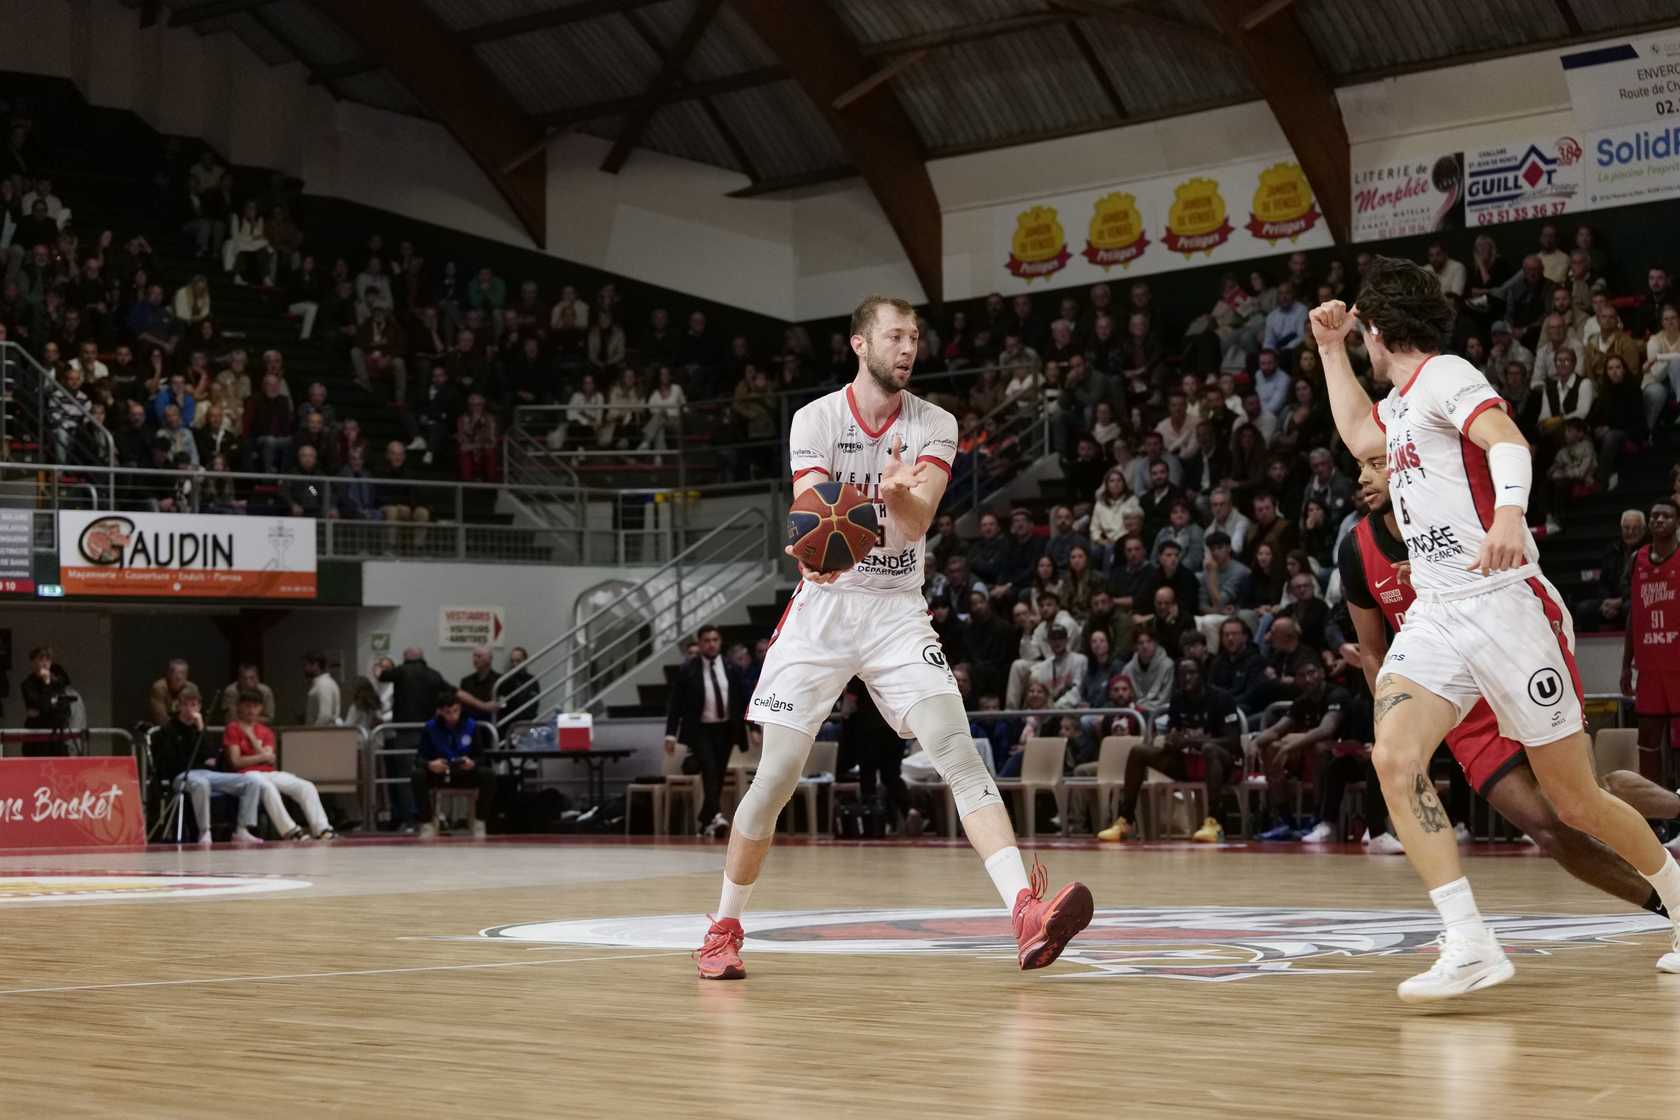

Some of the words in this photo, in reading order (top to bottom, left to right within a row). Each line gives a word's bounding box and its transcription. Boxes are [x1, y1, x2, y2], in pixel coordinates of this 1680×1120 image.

[1619, 87, 1649, 100] Route
[1651, 84, 1664, 95] de
[1655, 99, 1680, 116] 02.
[1354, 165, 1410, 184] LITERIE
[1415, 163, 1428, 175] de
[1478, 211, 1493, 225] 02
[1497, 209, 1510, 223] 51
[1551, 201, 1566, 216] 37
[78, 516, 234, 569] GAUDIN
[860, 549, 918, 570] ENDÉE
[1651, 610, 1665, 629] 91
[1643, 631, 1679, 645] SKF
[1390, 653, 1406, 661] ns
[0, 797, 24, 823] ns
[31, 783, 123, 822] Basket
